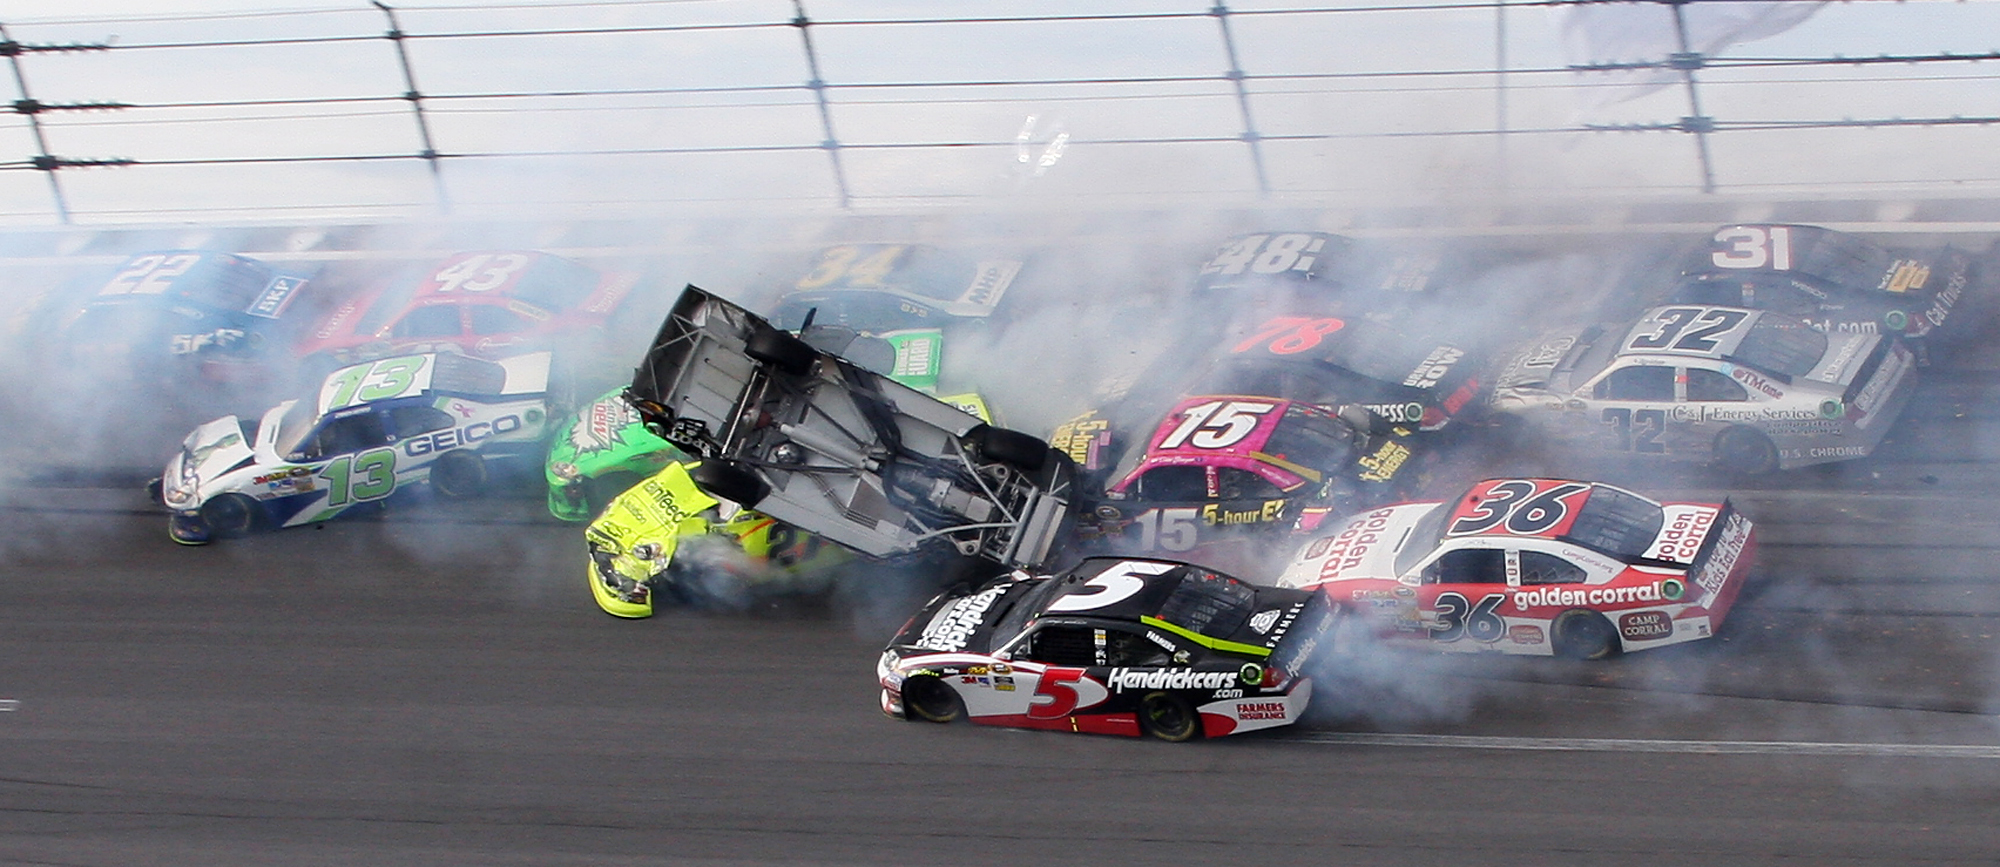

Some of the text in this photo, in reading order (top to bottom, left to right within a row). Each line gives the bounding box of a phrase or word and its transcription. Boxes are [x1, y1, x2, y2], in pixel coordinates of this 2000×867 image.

[795, 246, 905, 290] 34
[1712, 226, 1790, 271] 31
[97, 254, 202, 297] 22
[434, 253, 529, 291] 43
[1231, 316, 1345, 355] 78
[1628, 307, 1750, 354] 32
[328, 355, 429, 410] 13
[403, 414, 522, 458] GEICO
[1159, 400, 1276, 450] 15
[1600, 407, 1669, 454] 32
[1711, 406, 1760, 423] Energy
[1762, 405, 1817, 420] Services
[1810, 446, 1866, 458] CHROME
[320, 448, 397, 505] 13
[1135, 508, 1198, 552] 15
[1202, 503, 1260, 527] 5-hour
[1448, 480, 1592, 536] 36
[1340, 508, 1395, 571] golden
[1657, 512, 1695, 562] golden
[1677, 510, 1721, 559] corral
[1047, 560, 1177, 612] 5
[1513, 581, 1662, 611] golden corral
[1265, 602, 1305, 648] FARMERS
[1427, 592, 1508, 644] 36
[1624, 623, 1670, 638] CORRAL
[1628, 615, 1661, 627] CAMP
[1027, 667, 1089, 720] 5
[1107, 667, 1238, 695] Hendrickcars
[1236, 702, 1285, 714] FARMERS
[1238, 712, 1287, 721] INSURANCE
